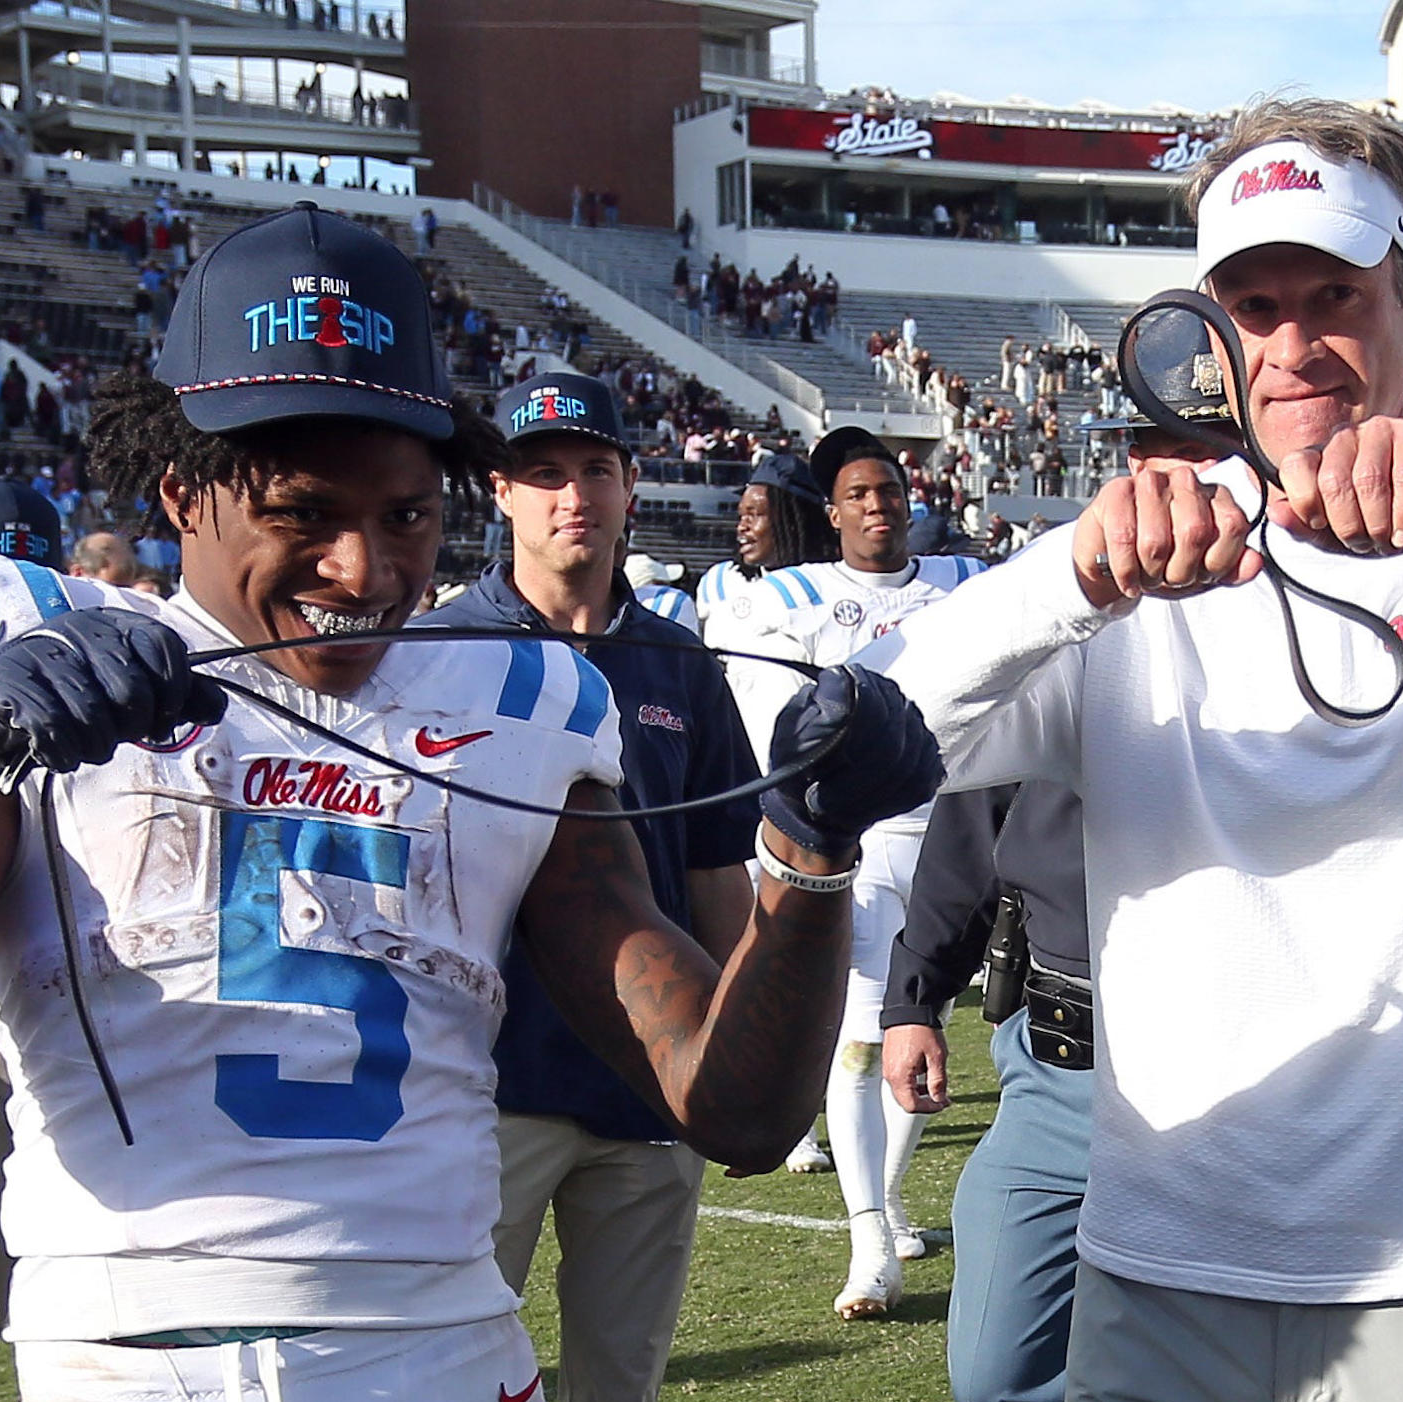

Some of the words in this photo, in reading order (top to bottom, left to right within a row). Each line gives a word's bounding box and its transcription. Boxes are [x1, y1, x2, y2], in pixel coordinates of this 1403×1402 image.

[833, 113, 933, 156] State
[1263, 160, 1323, 193] Miss
[292, 276, 317, 293] WE
[320, 277, 350, 296] RUN
[244, 296, 319, 352] THE
[339, 300, 394, 354] SIP
[511, 397, 544, 433] THE
[553, 395, 586, 418] SIP
[26, 534, 49, 558] SIP
[835, 603, 860, 624] SEC
[243, 758, 298, 806] Ole
[298, 761, 384, 816] Miss
[214, 811, 411, 1142] 5
